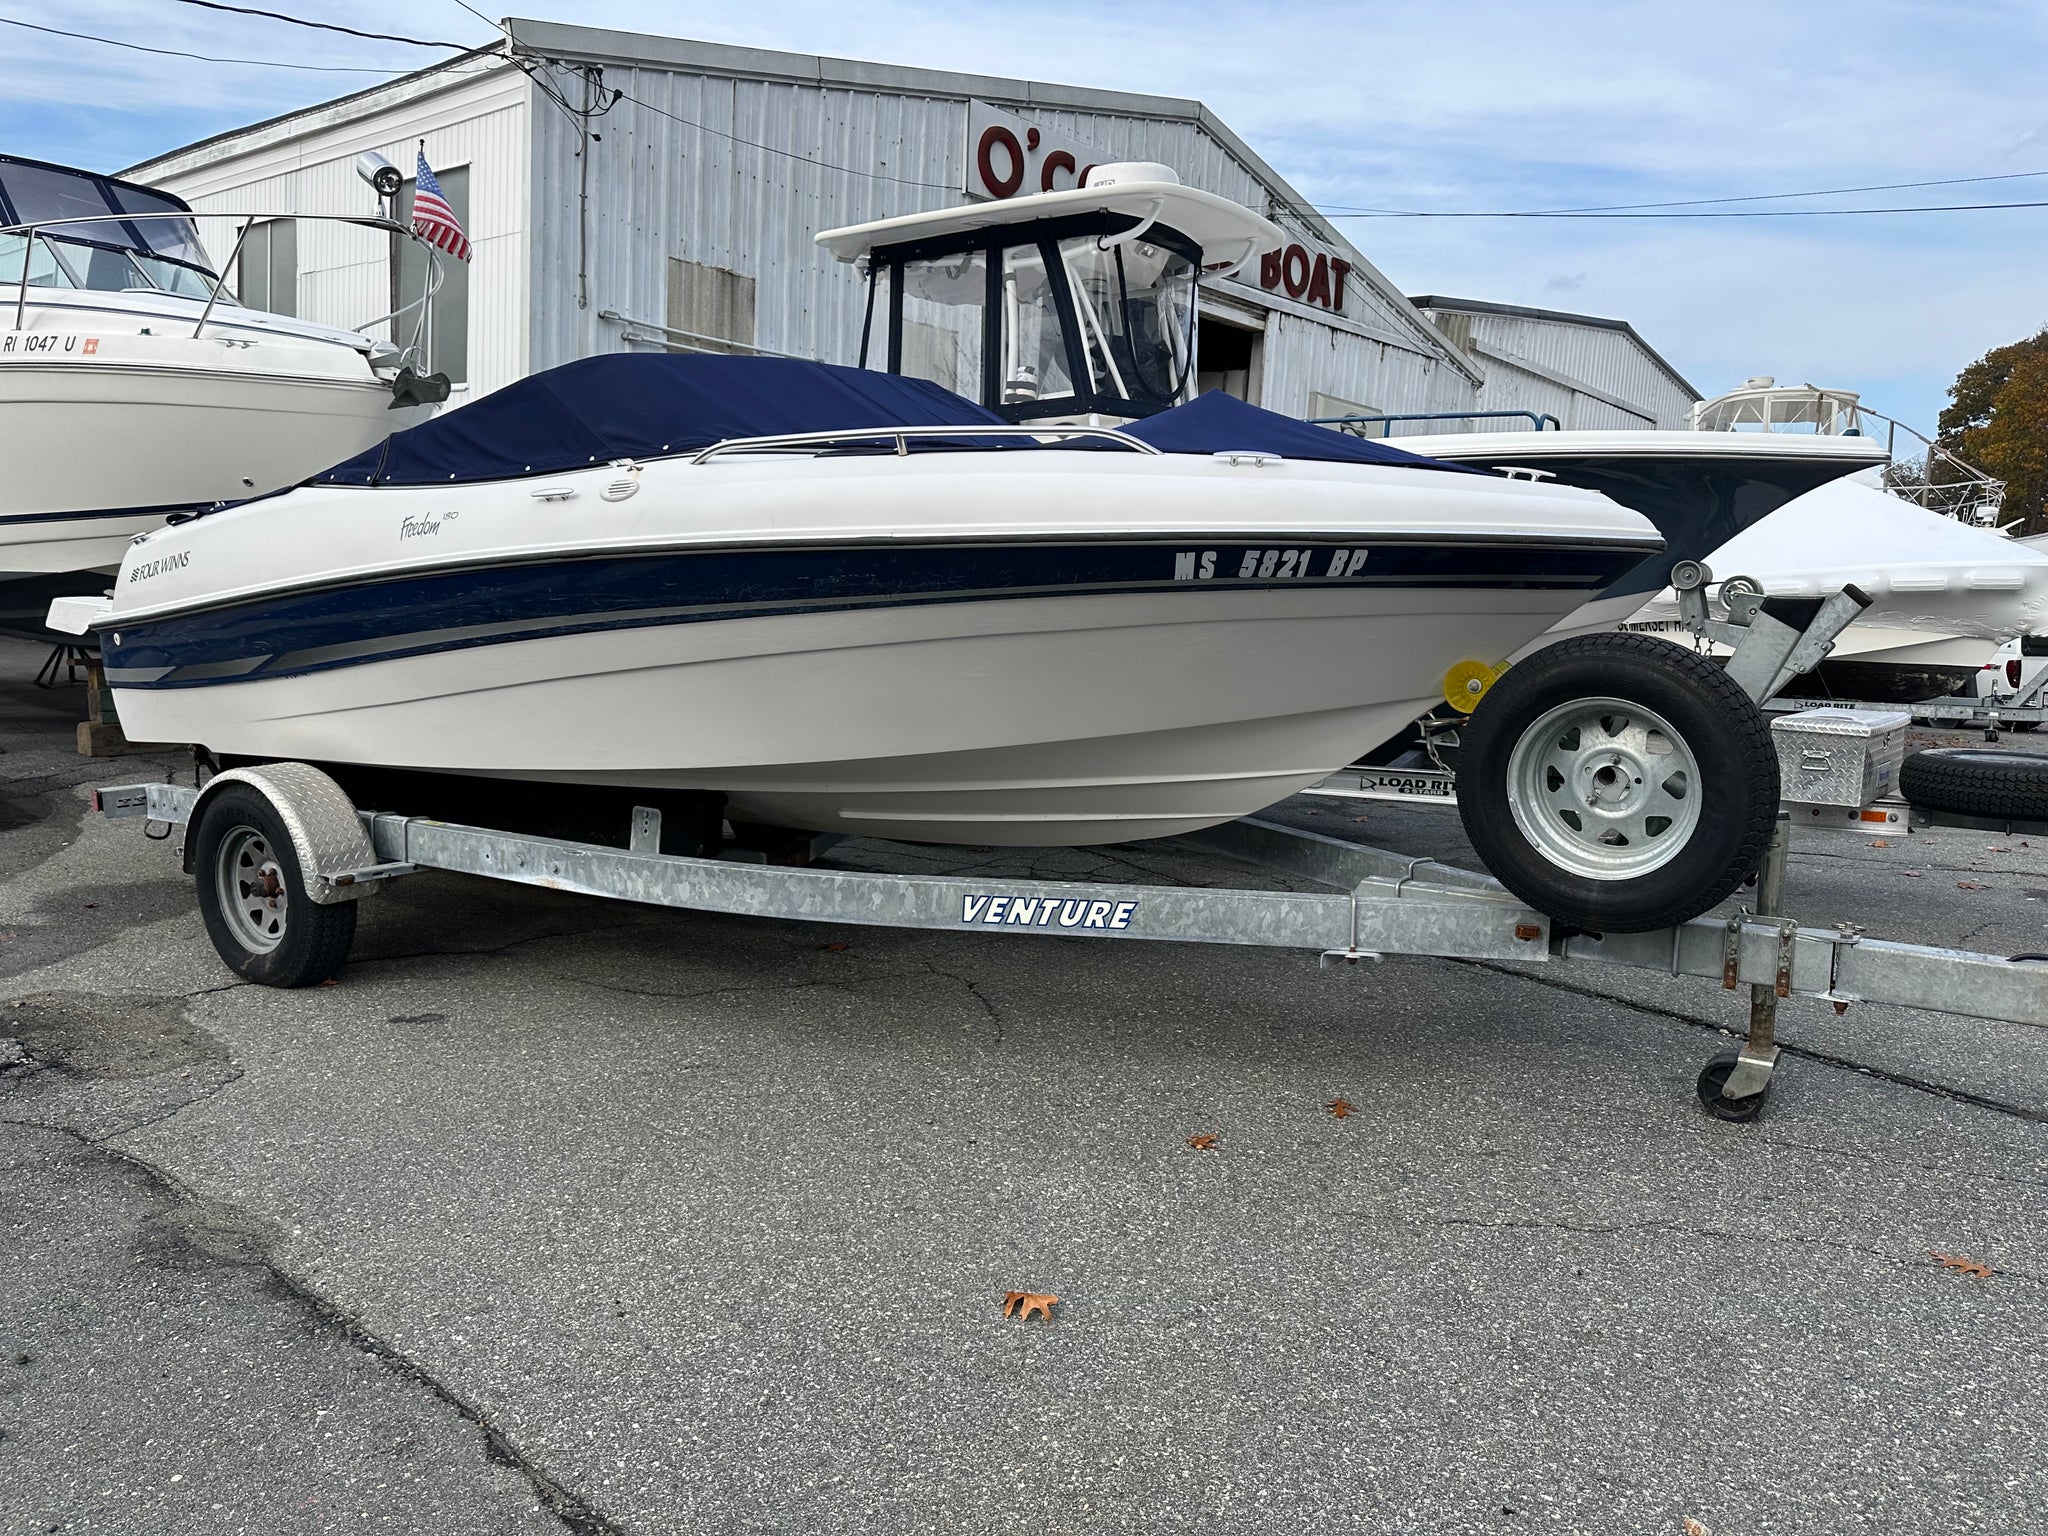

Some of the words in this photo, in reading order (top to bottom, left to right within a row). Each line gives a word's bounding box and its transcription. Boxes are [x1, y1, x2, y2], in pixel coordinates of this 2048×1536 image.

[977, 125, 1099, 199] O'C
[1260, 243, 1351, 312] BOAT
[3, 336, 18, 352] RI
[24, 336, 58, 352] 1047
[64, 336, 77, 352] U
[400, 511, 440, 541] Freedom
[139, 560, 160, 581] FOUR
[161, 550, 191, 574] WINNS
[1174, 551, 1217, 580] MS
[1238, 549, 1312, 578] 5821
[1326, 549, 1369, 577] BP
[1378, 777, 1427, 789] LOAD
[1431, 780, 1456, 791] RIT
[962, 895, 1139, 930] VENTURE
